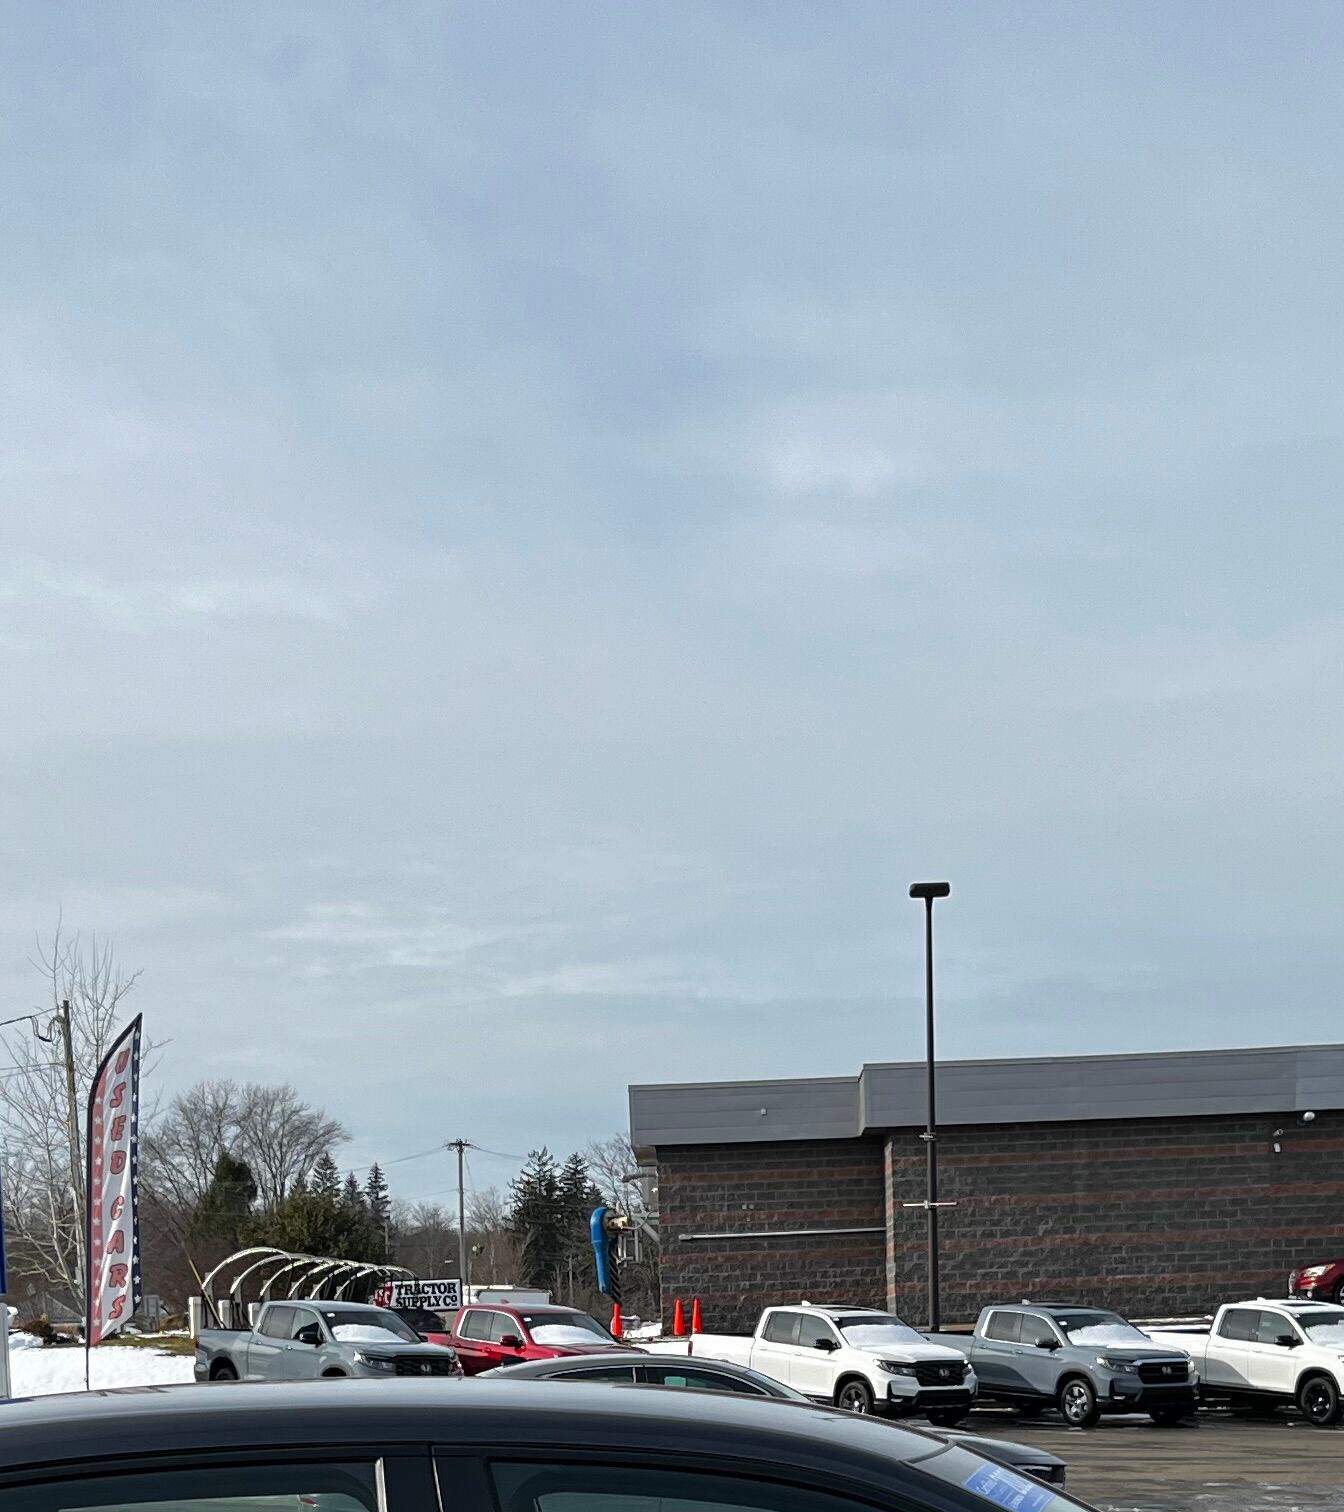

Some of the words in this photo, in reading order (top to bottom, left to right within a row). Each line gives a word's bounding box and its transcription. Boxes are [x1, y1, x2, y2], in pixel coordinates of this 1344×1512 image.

[109, 1047, 131, 1175] USED
[106, 1195, 129, 1320] CARS
[394, 1282, 457, 1296] TRACTOR
[395, 1295, 442, 1309] SUPPLY
